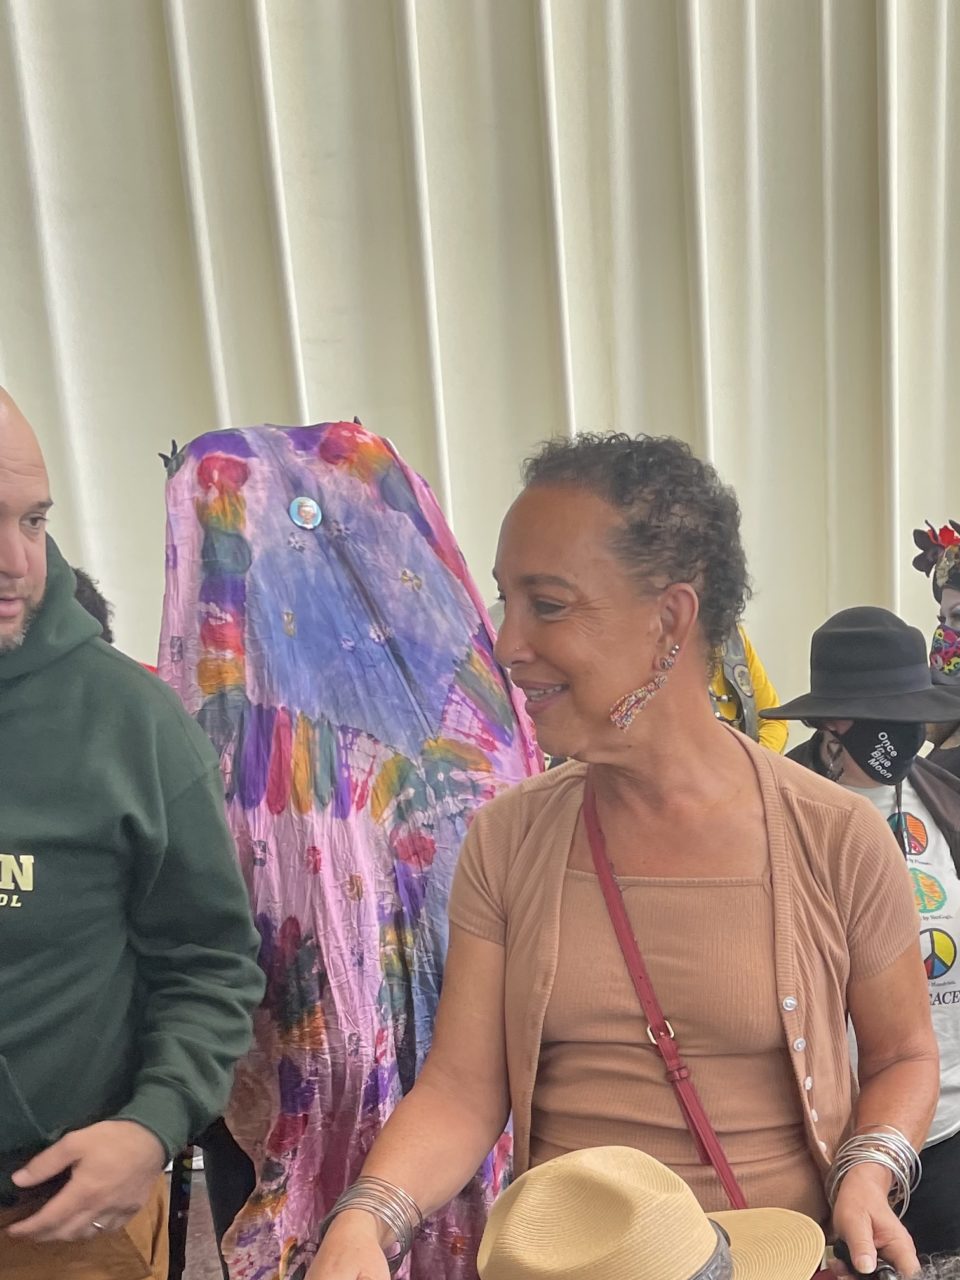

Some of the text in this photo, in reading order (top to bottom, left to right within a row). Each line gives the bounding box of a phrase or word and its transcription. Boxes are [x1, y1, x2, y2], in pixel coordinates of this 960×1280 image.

[878, 732, 898, 757] Once
[868, 758, 892, 778] Moon
[871, 750, 891, 767] Blue
